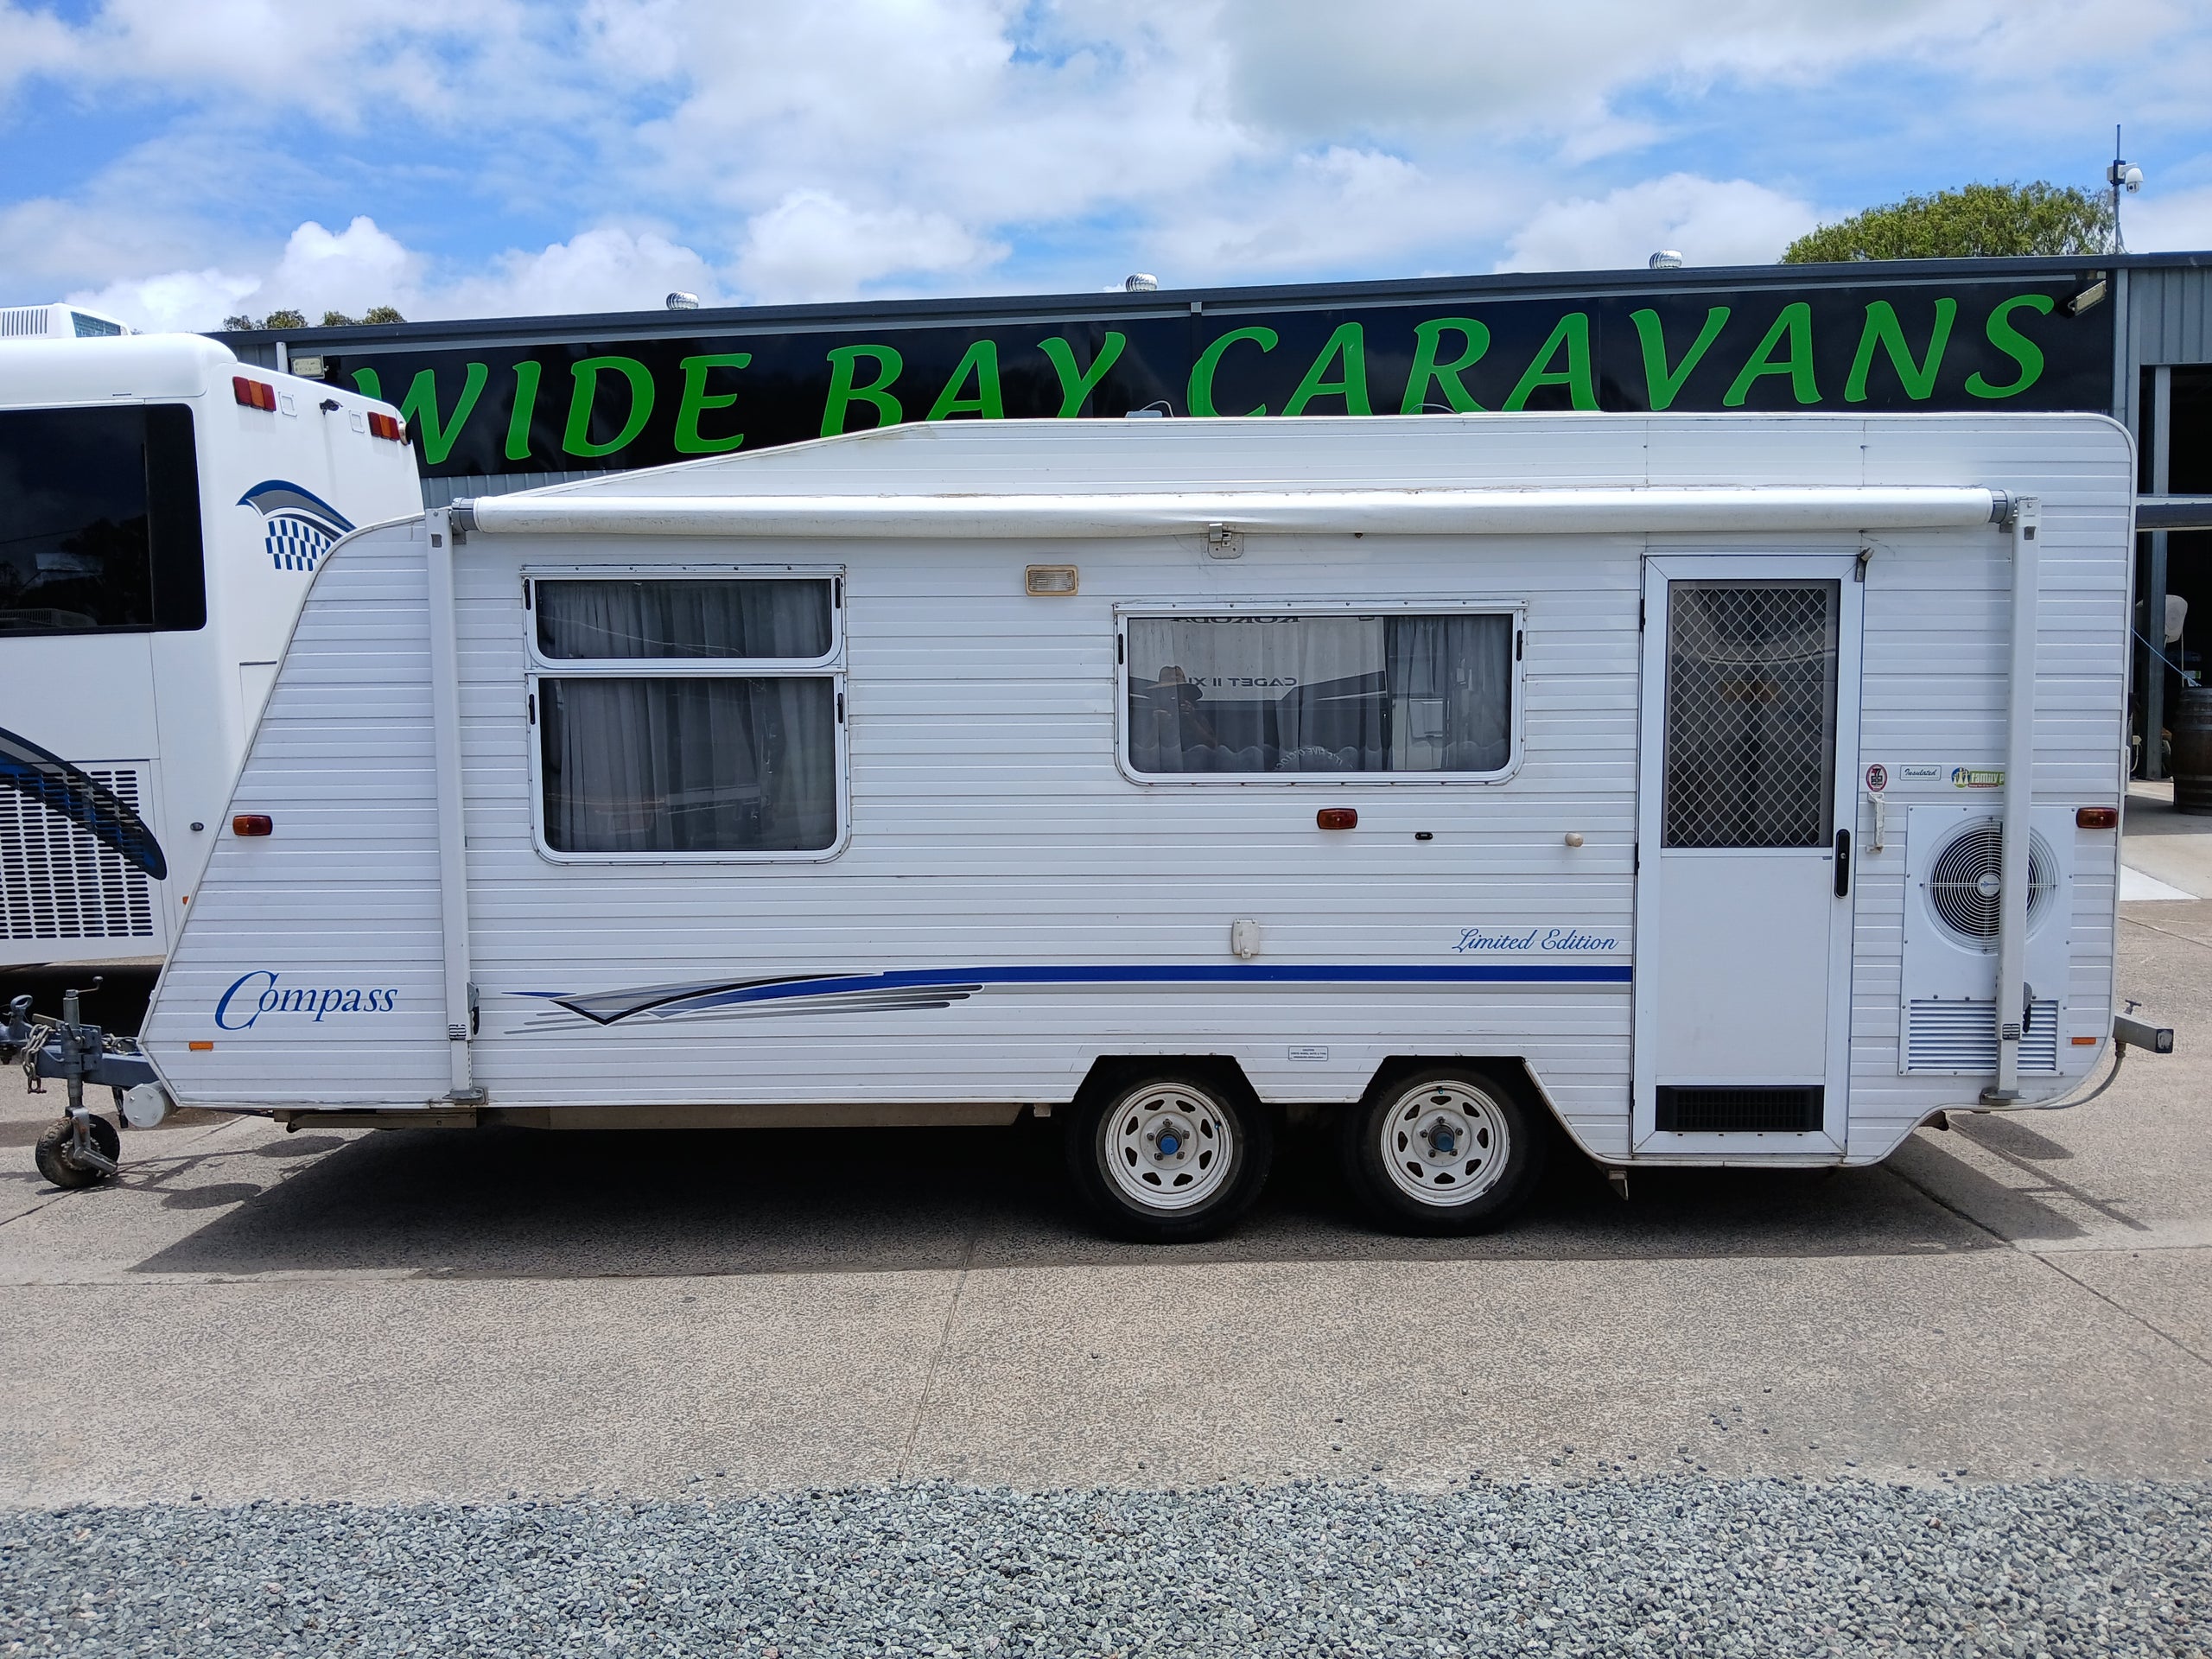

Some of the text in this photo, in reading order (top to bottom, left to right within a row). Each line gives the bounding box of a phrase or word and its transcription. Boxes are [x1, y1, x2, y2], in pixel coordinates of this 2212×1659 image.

[352, 294, 2055, 465] WIDE BAY CARAVANS
[1452, 928, 1618, 953] Limited Edition
[214, 969, 398, 1031] Compass
